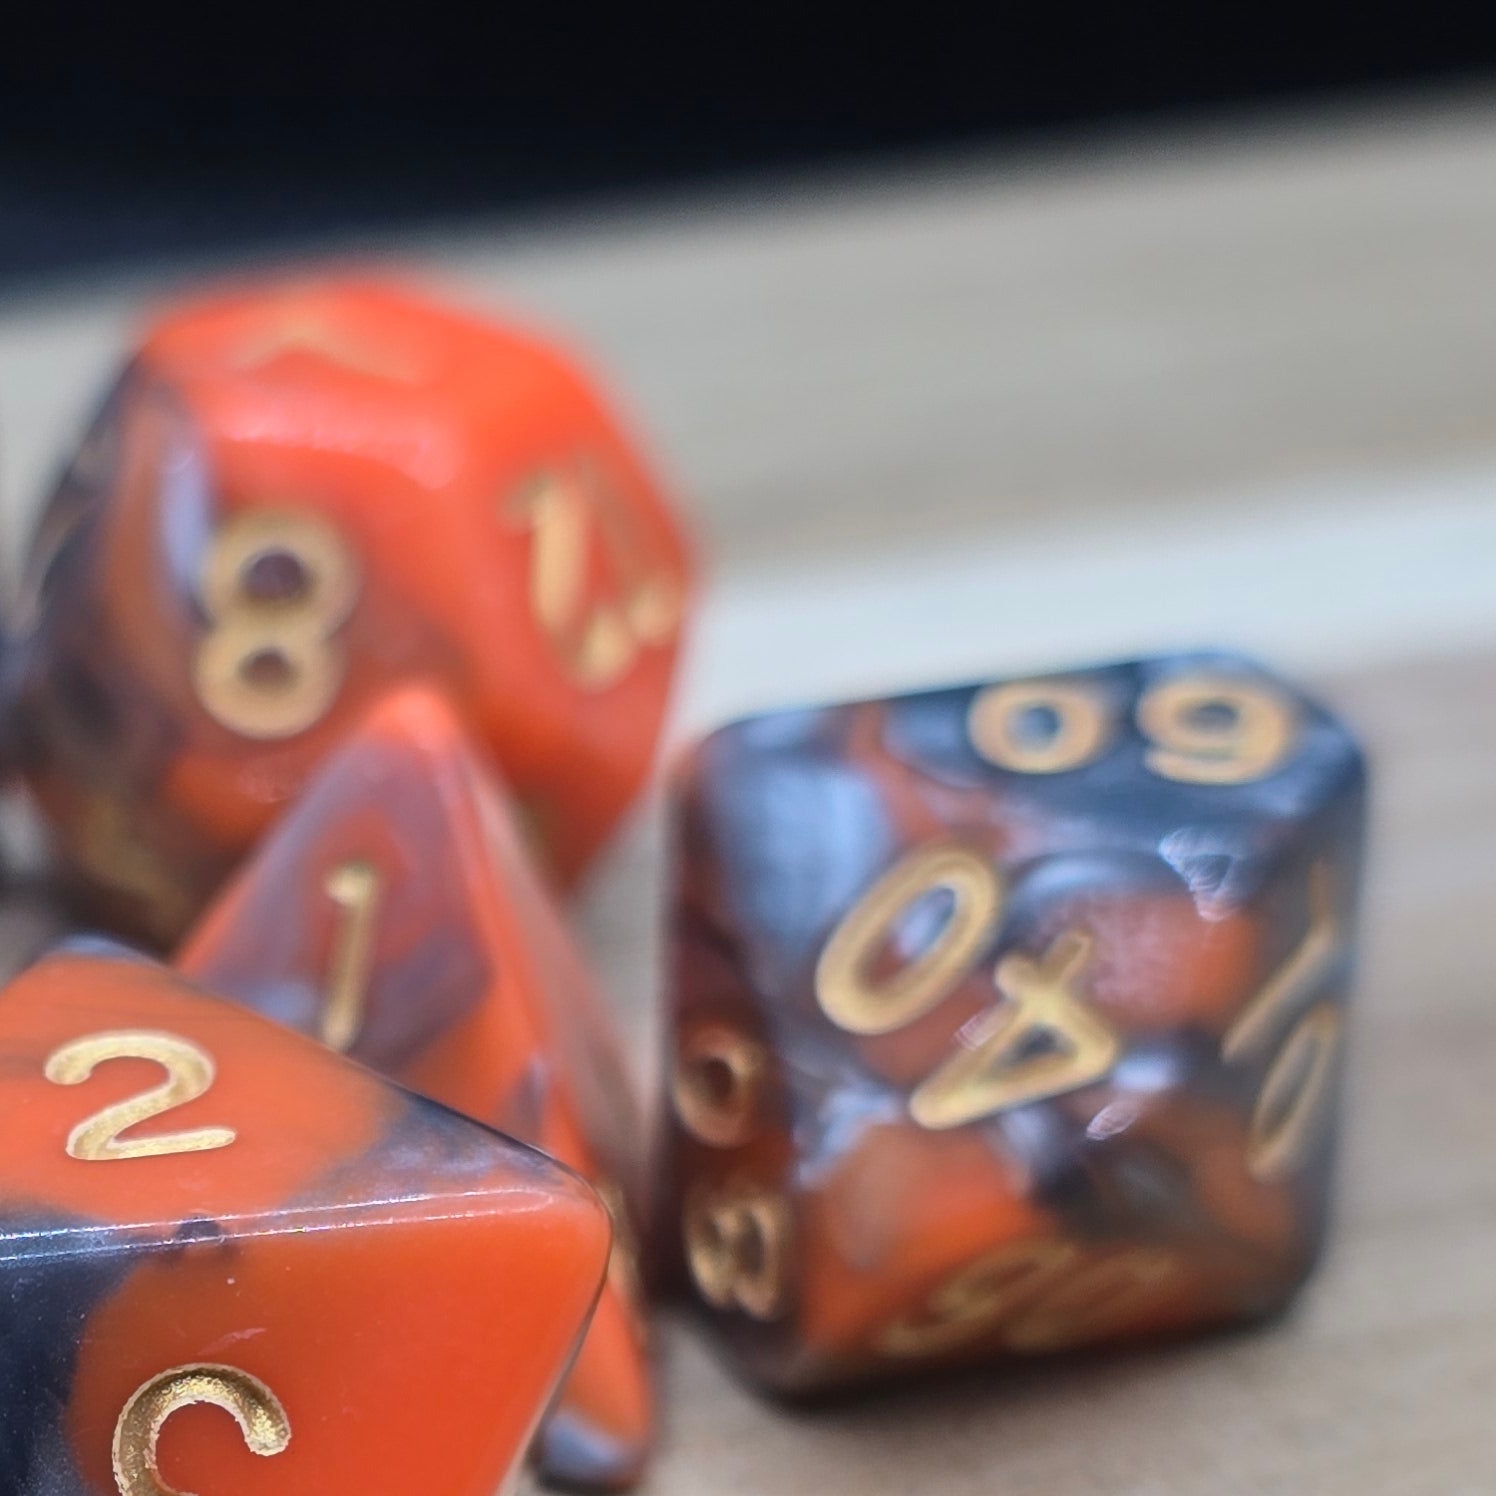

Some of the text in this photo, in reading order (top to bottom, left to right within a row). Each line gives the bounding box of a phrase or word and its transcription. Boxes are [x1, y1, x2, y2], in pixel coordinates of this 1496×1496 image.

[192, 508, 359, 742] 8
[322, 862, 384, 1048] 1
[814, 848, 1122, 1130] 40
[42, 1031, 237, 1160] 2
